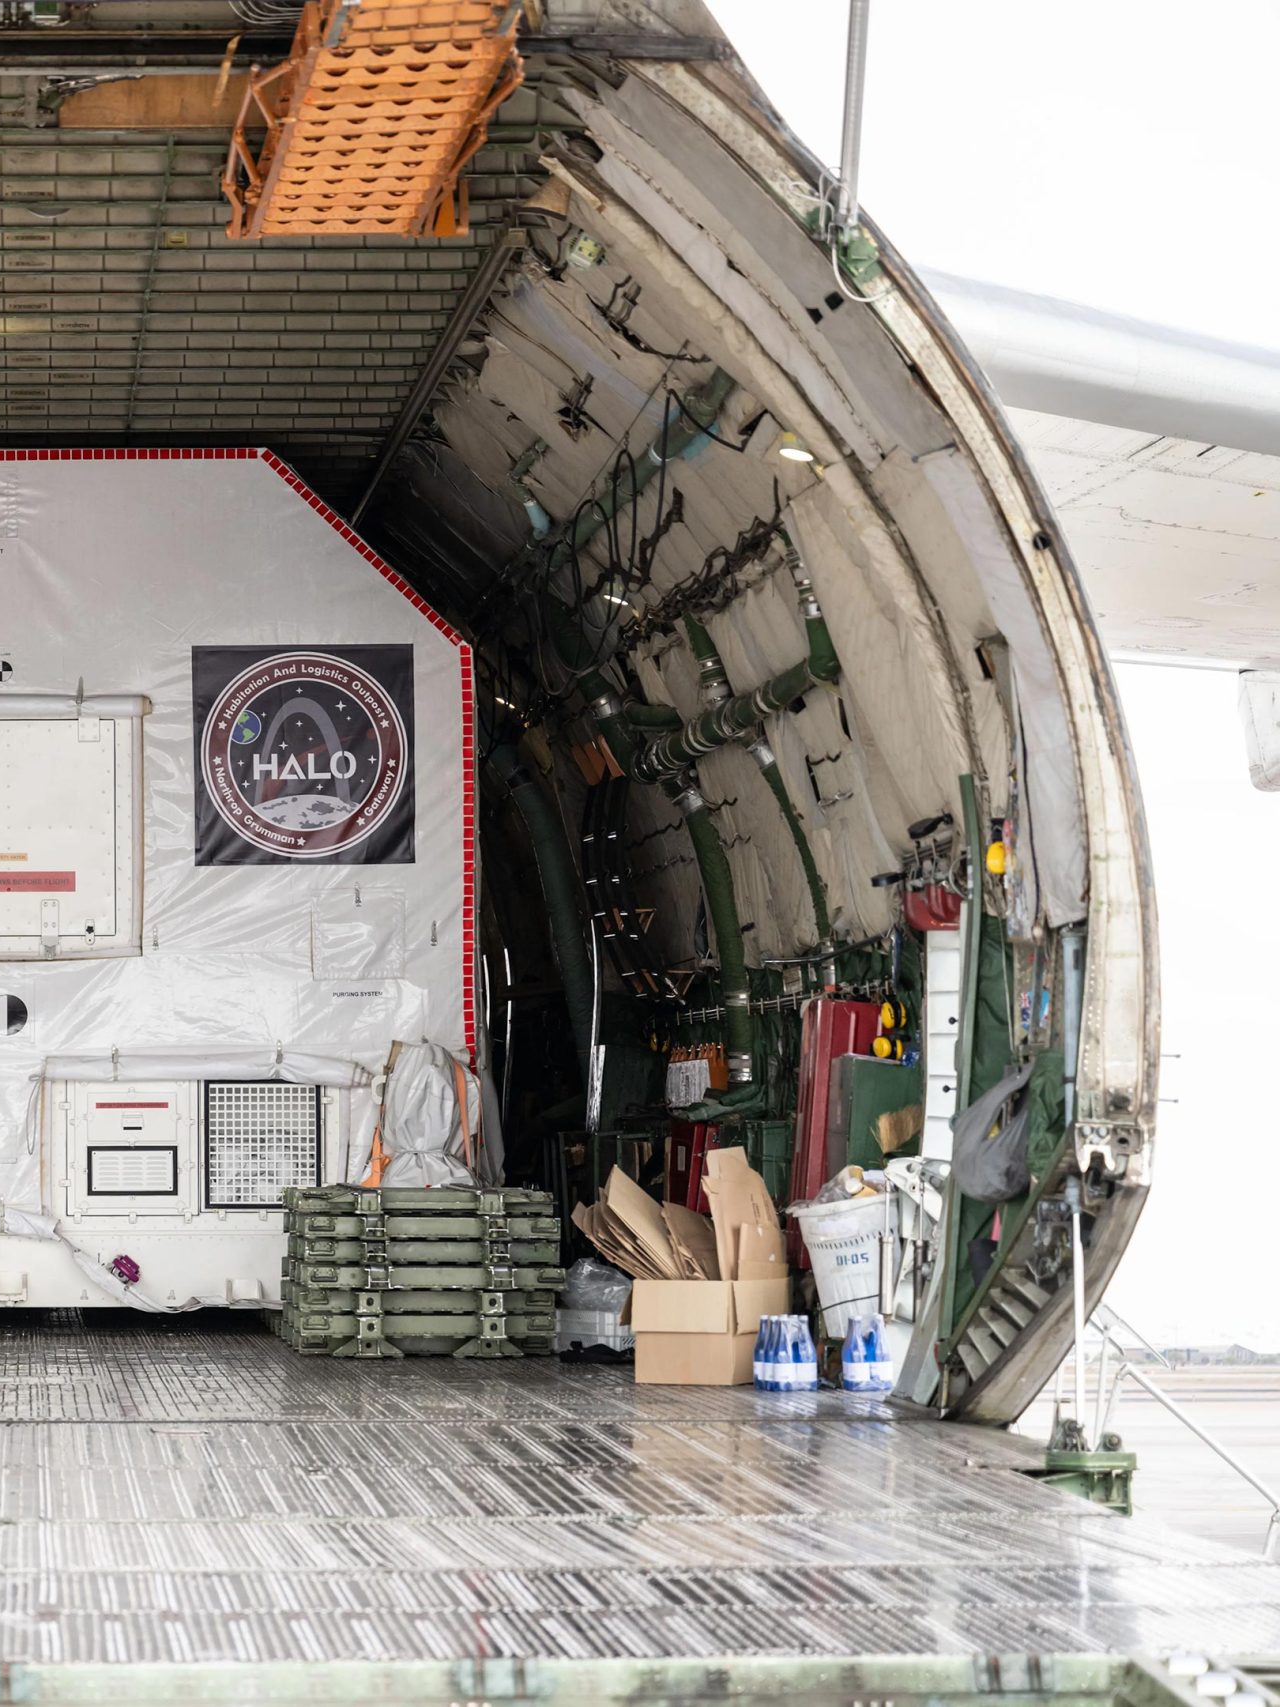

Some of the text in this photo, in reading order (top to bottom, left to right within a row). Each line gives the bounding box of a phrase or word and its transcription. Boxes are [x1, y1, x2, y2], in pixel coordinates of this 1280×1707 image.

[223, 664, 385, 719] Habitation And Logistics Outpost
[252, 751, 357, 780] HALO
[215, 767, 295, 845] Northrop Grumman
[364, 770, 395, 816] Gateway
